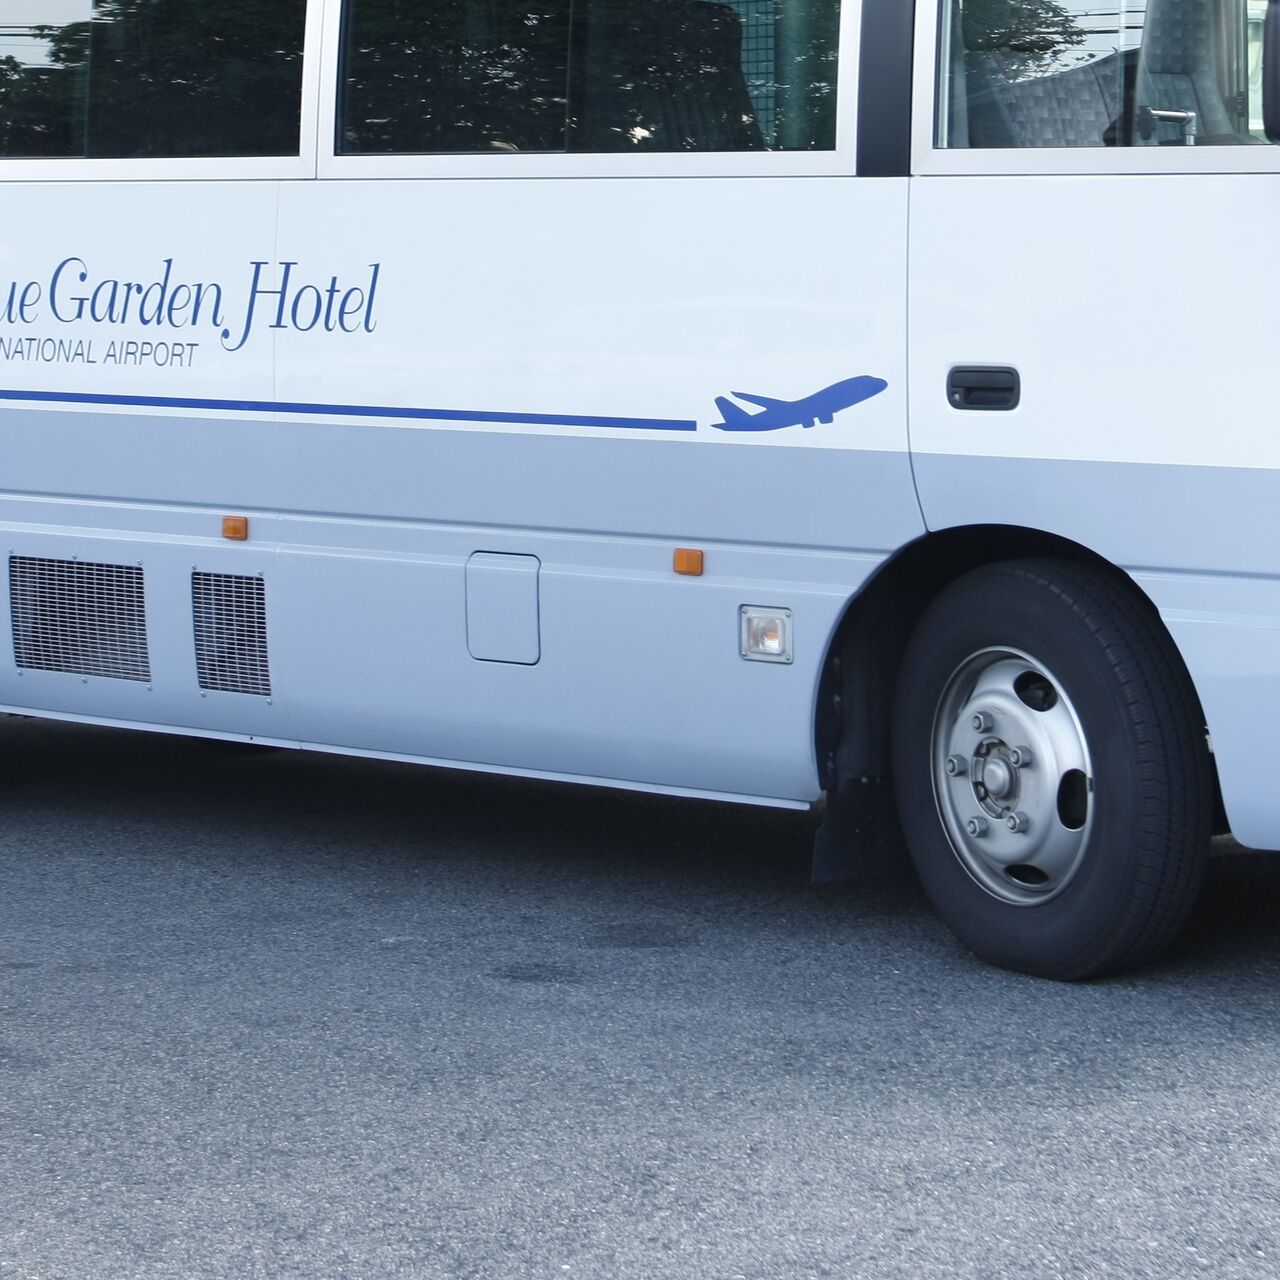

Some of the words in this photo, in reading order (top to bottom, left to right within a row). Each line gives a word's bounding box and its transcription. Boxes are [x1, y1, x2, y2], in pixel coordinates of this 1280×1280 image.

[49, 257, 224, 328] Garden
[220, 261, 381, 352] Hotel
[103, 340, 199, 367] AIRPORT
